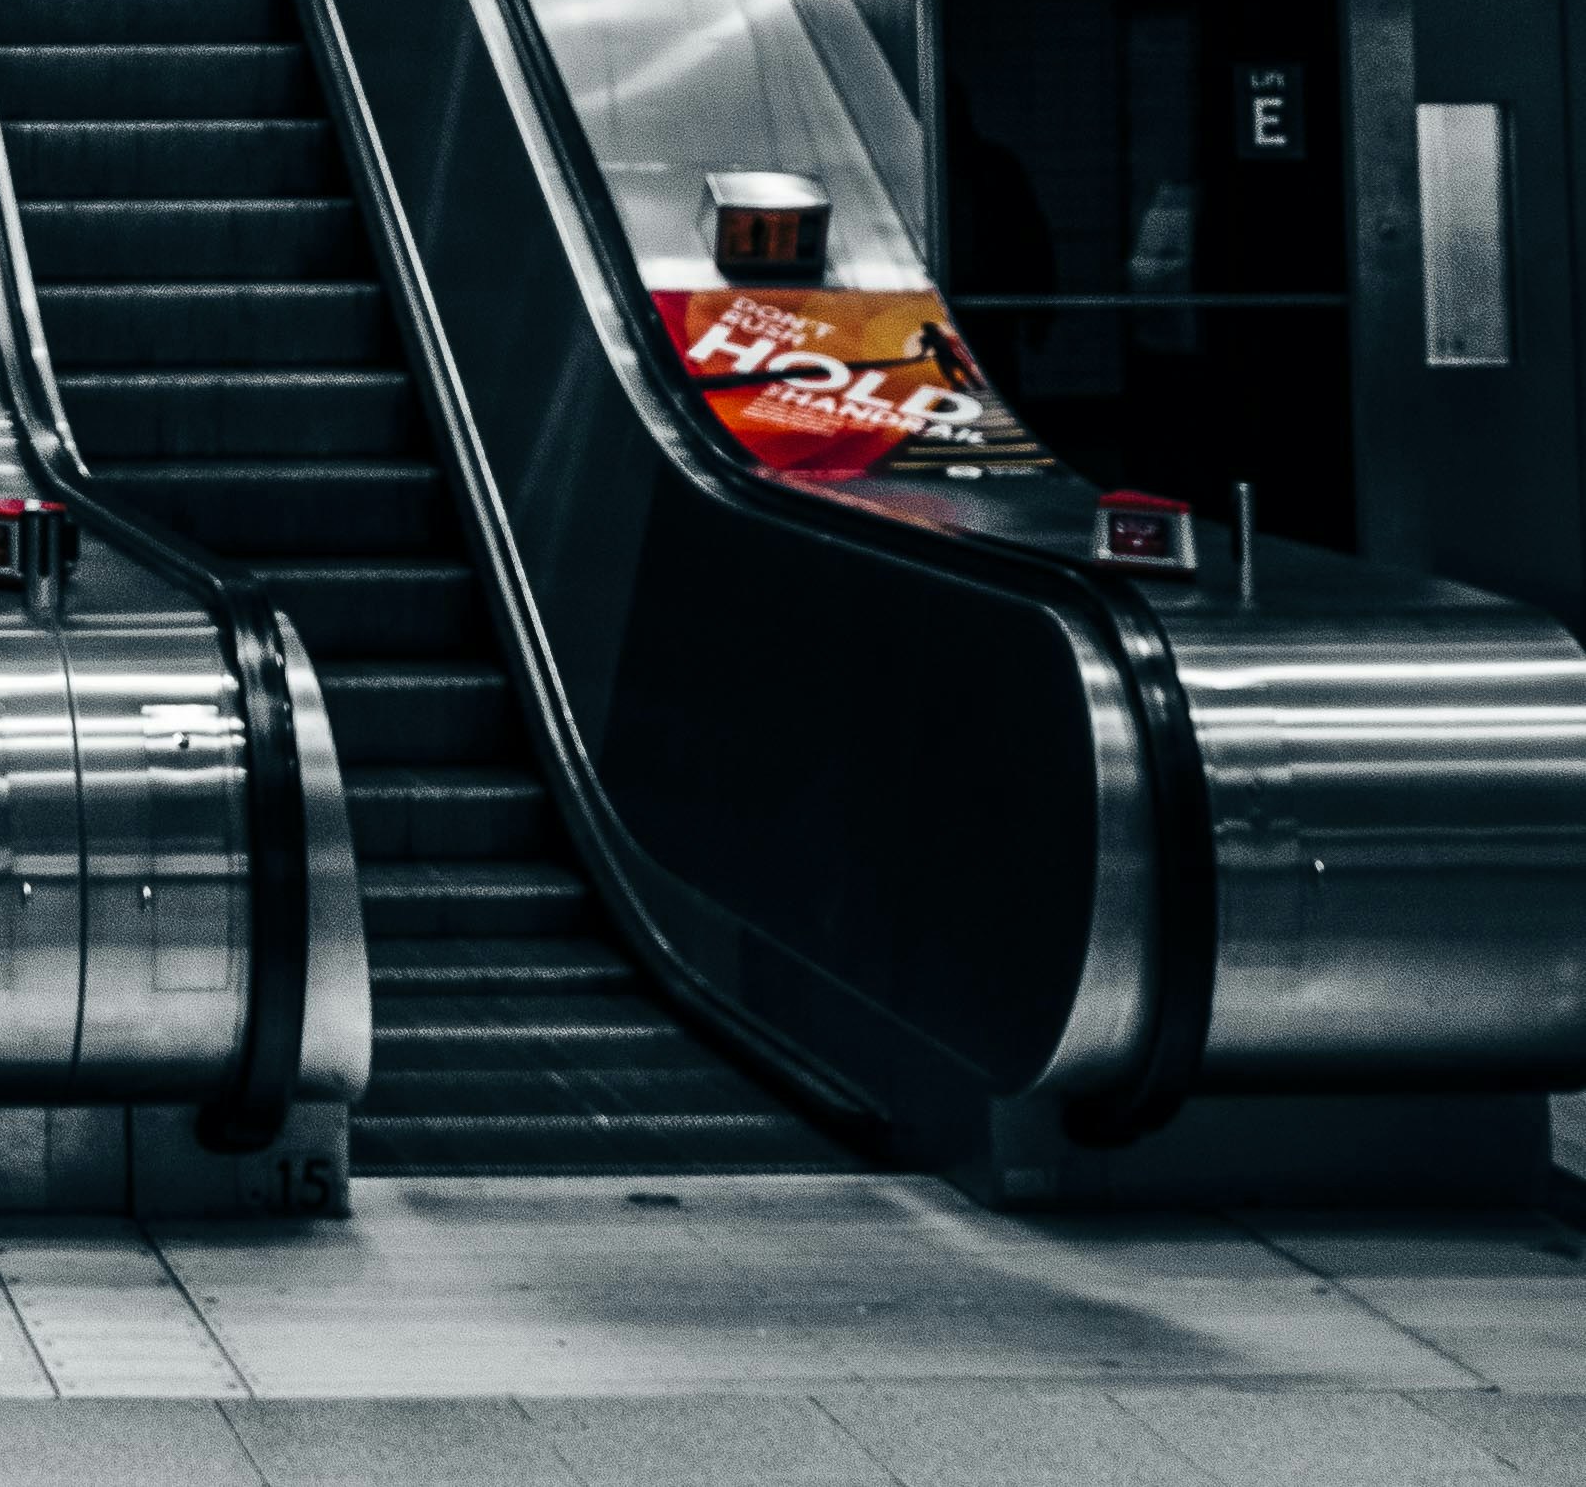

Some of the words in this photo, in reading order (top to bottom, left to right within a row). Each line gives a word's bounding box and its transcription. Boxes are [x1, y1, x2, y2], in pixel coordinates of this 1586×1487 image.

[1252, 96, 1288, 148] E
[686, 322, 984, 423] HOLD
[277, 1158, 330, 1215] 15
